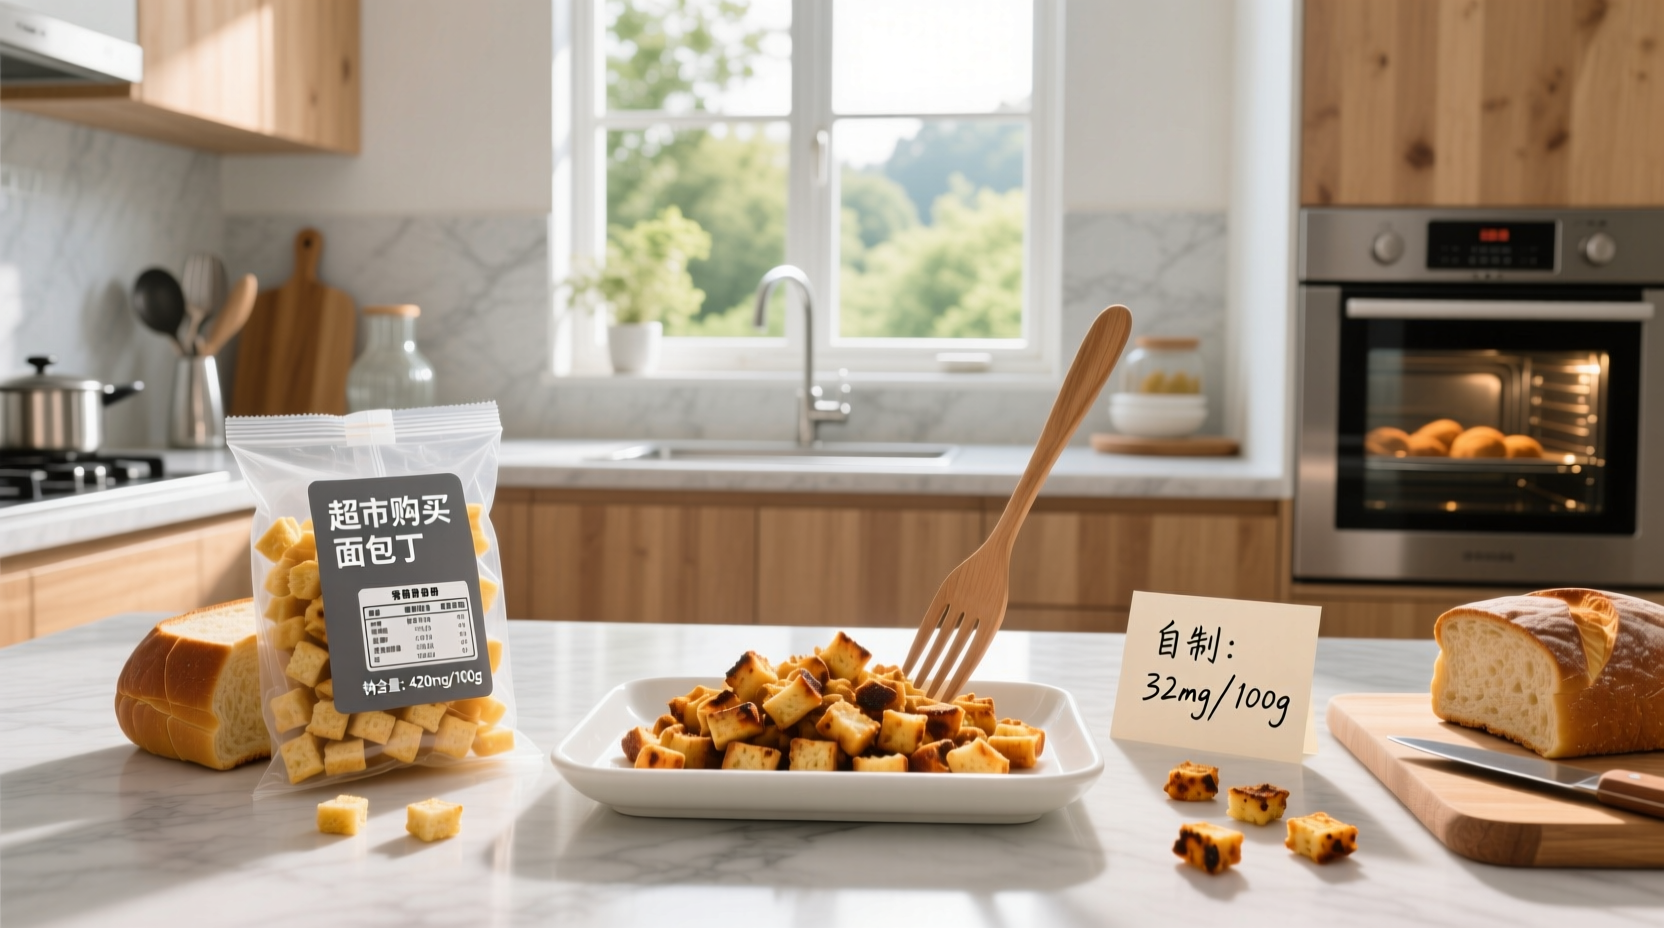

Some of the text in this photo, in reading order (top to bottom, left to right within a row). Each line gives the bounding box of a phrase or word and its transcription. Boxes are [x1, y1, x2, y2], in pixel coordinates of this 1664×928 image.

[328, 494, 451, 532] 超市购买
[333, 533, 424, 569] 面包丁
[1142, 672, 1290, 728] 32mg/100g
